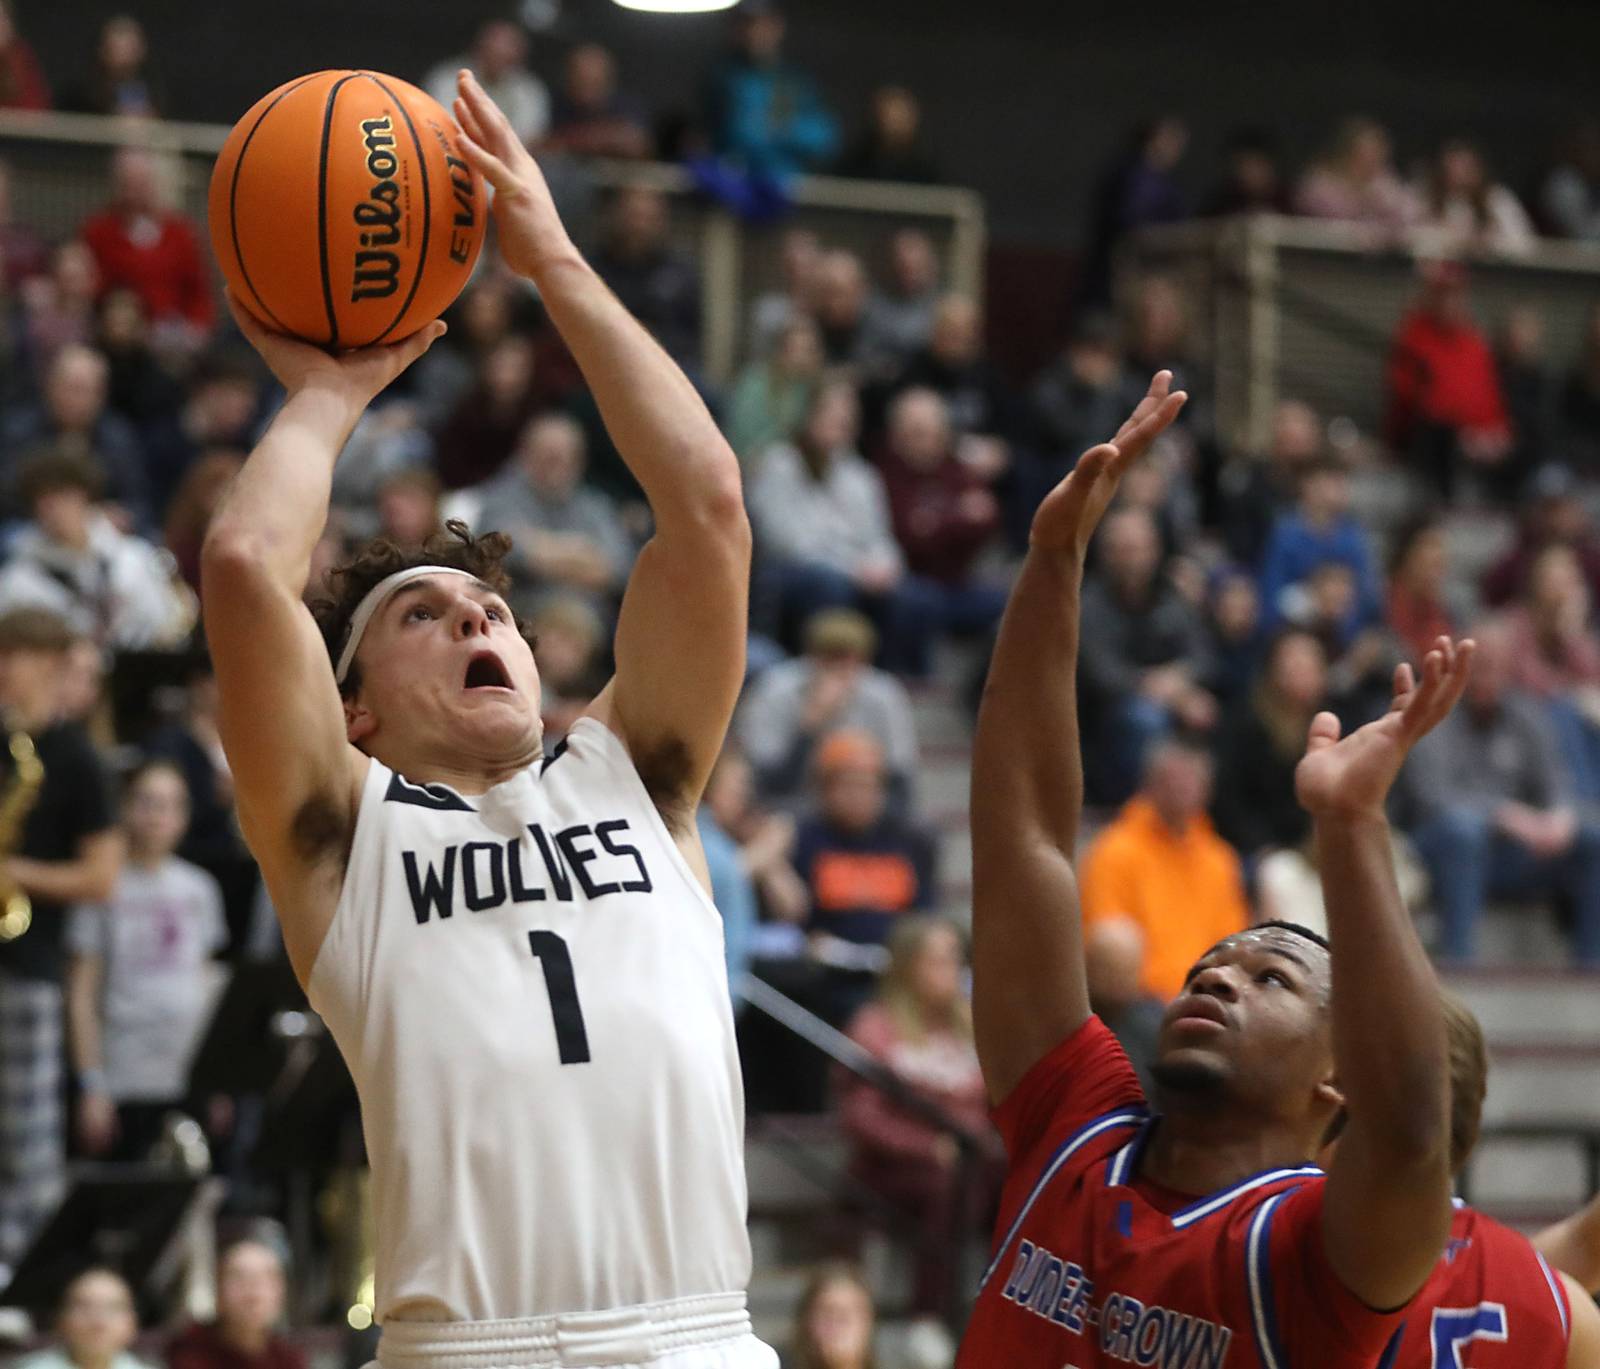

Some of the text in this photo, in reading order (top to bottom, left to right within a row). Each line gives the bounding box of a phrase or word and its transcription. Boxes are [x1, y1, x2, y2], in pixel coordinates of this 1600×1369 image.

[351, 116, 401, 303] Wilson
[402, 818, 653, 924] WOLVES
[528, 929, 590, 1065] 1
